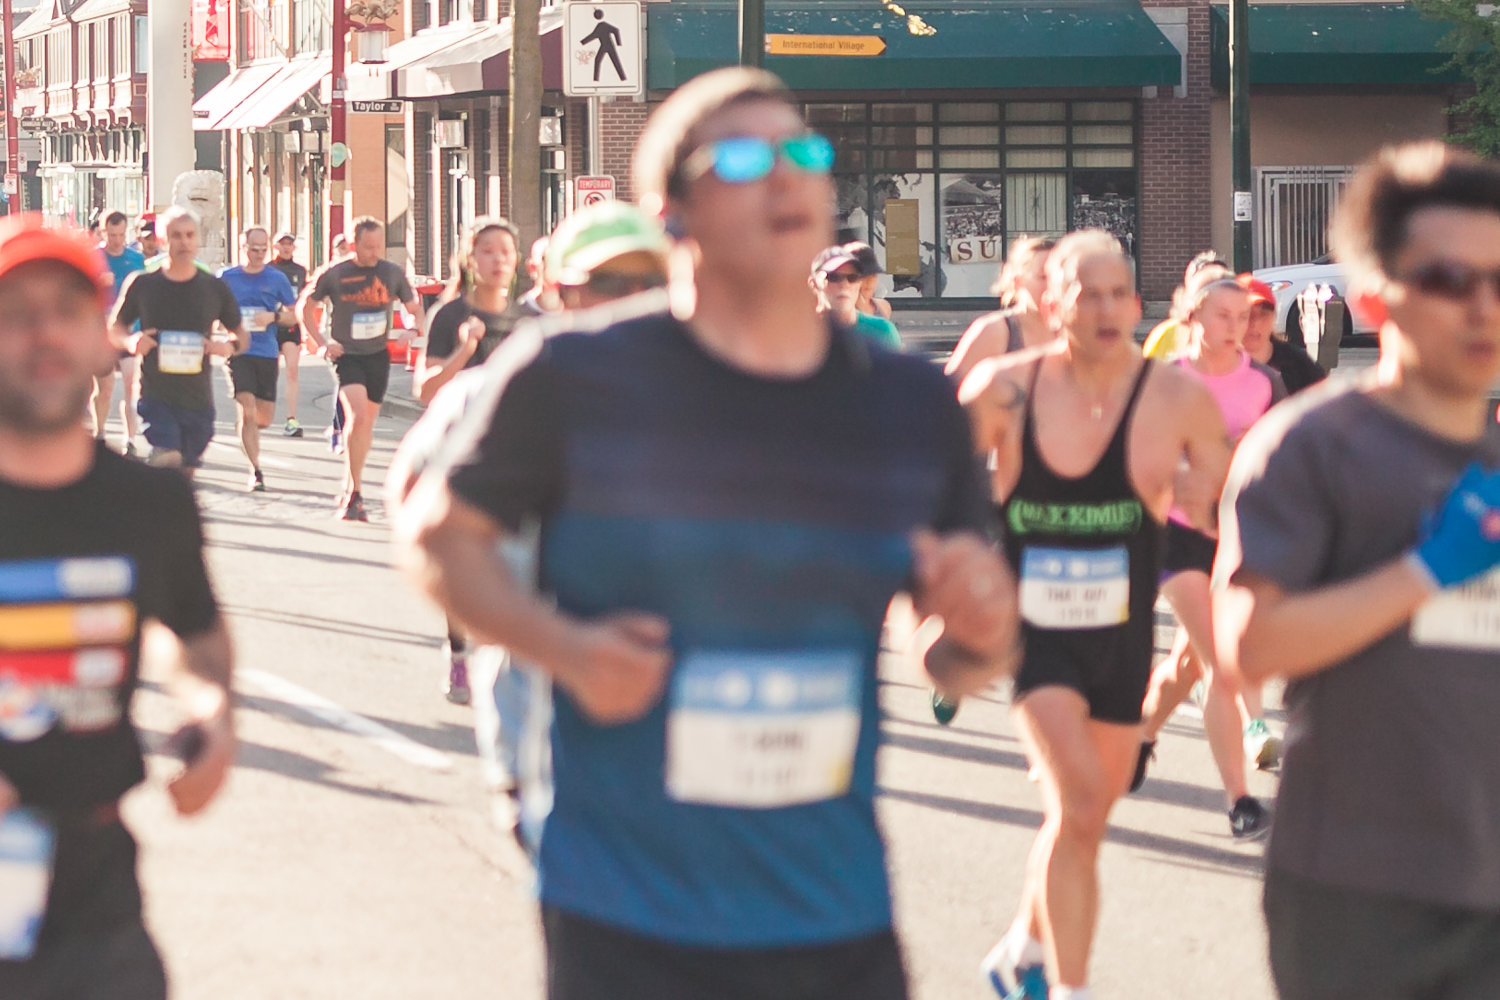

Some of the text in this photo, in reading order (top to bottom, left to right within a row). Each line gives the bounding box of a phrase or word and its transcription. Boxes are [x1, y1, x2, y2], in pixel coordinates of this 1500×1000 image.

[783, 40, 865, 52] International Village
[354, 102, 385, 112] Taylor
